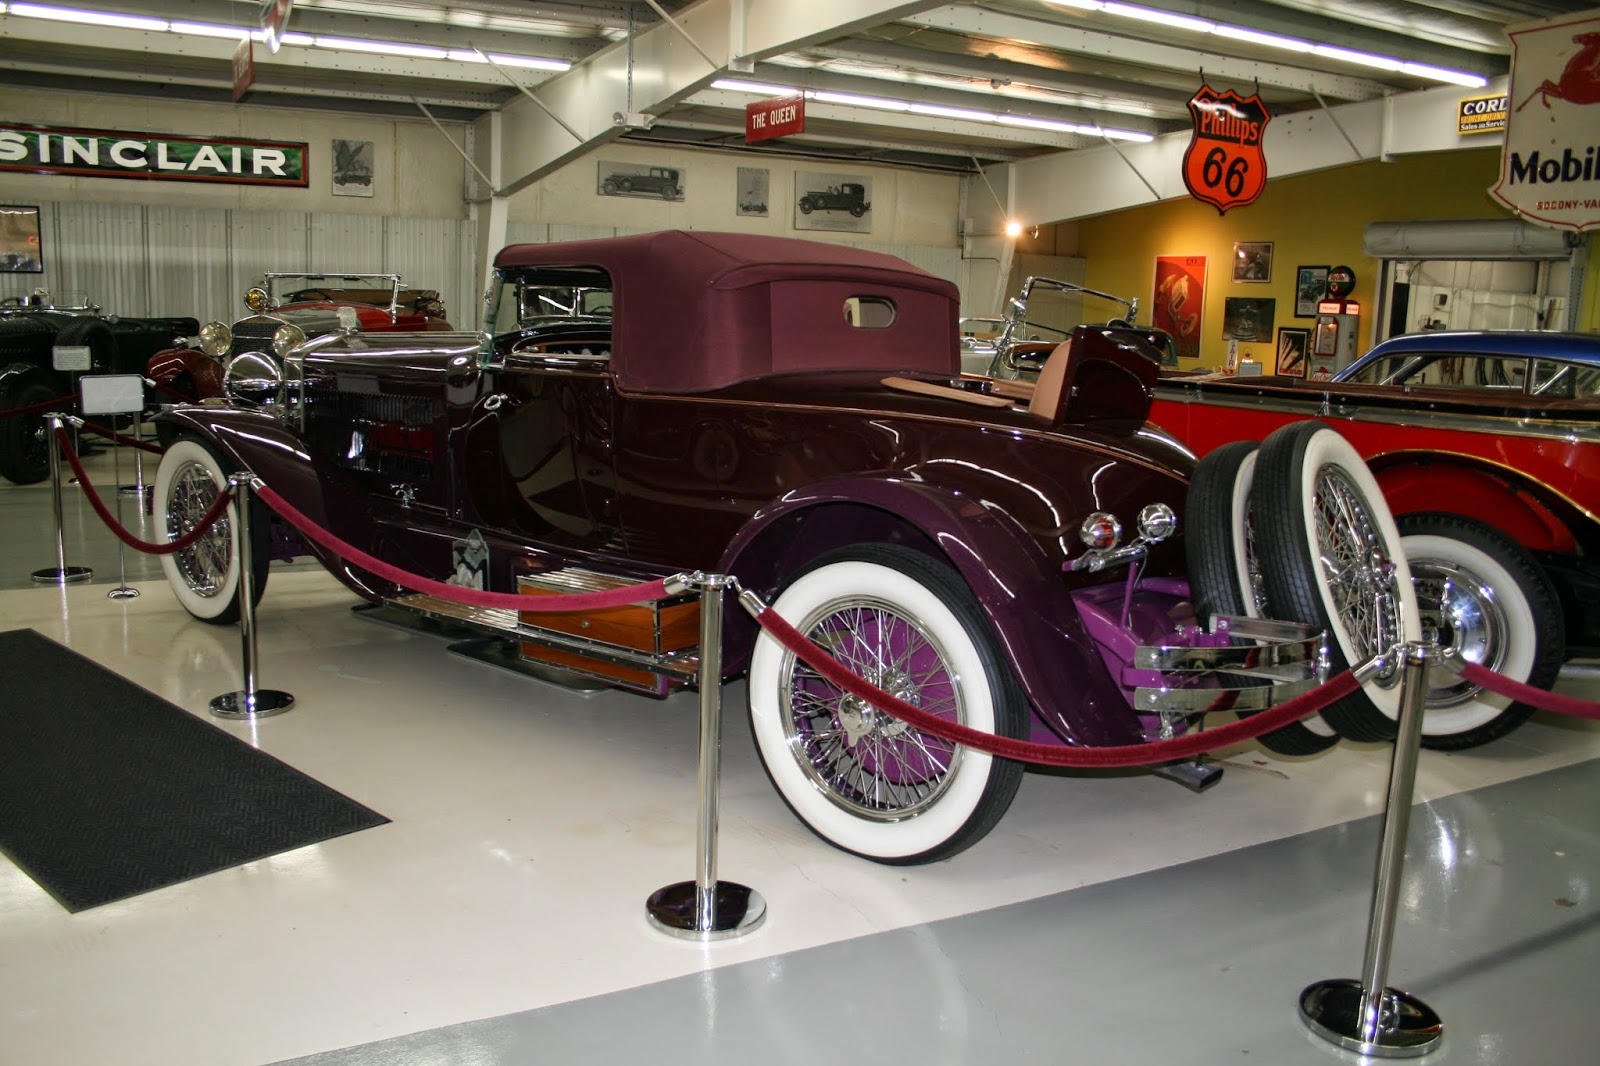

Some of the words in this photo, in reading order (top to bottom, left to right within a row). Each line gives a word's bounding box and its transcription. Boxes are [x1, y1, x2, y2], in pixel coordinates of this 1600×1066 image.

[752, 112, 766, 129] THE
[770, 105, 796, 125] QUEEN
[1200, 98, 1259, 147] Phillips
[0, 132, 287, 176] SINCLAIR
[1203, 147, 1248, 197] 66
[1536, 200, 1600, 210] SOCONY-VA
